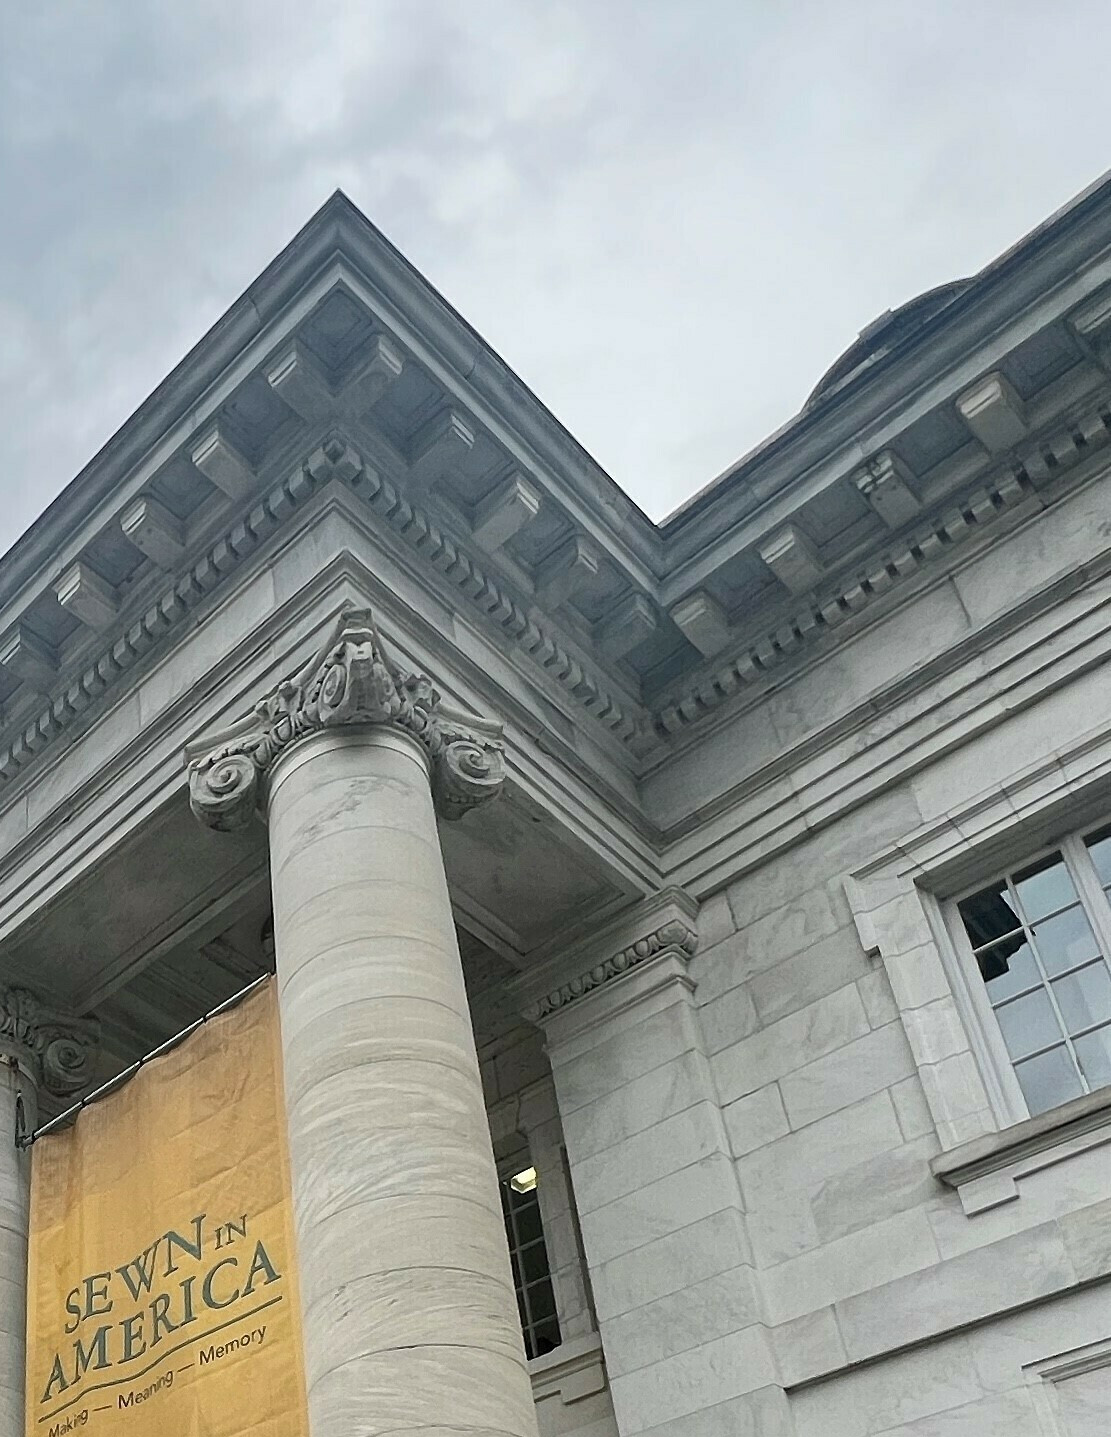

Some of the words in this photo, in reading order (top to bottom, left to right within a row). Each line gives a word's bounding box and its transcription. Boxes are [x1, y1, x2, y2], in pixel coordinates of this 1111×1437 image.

[39, 1239, 283, 1404] AMERICA
[64, 1213, 207, 1334] SEWN
[214, 1214, 248, 1250] IN
[118, 1369, 174, 1410] Meaning
[199, 1325, 267, 1366] Memory
